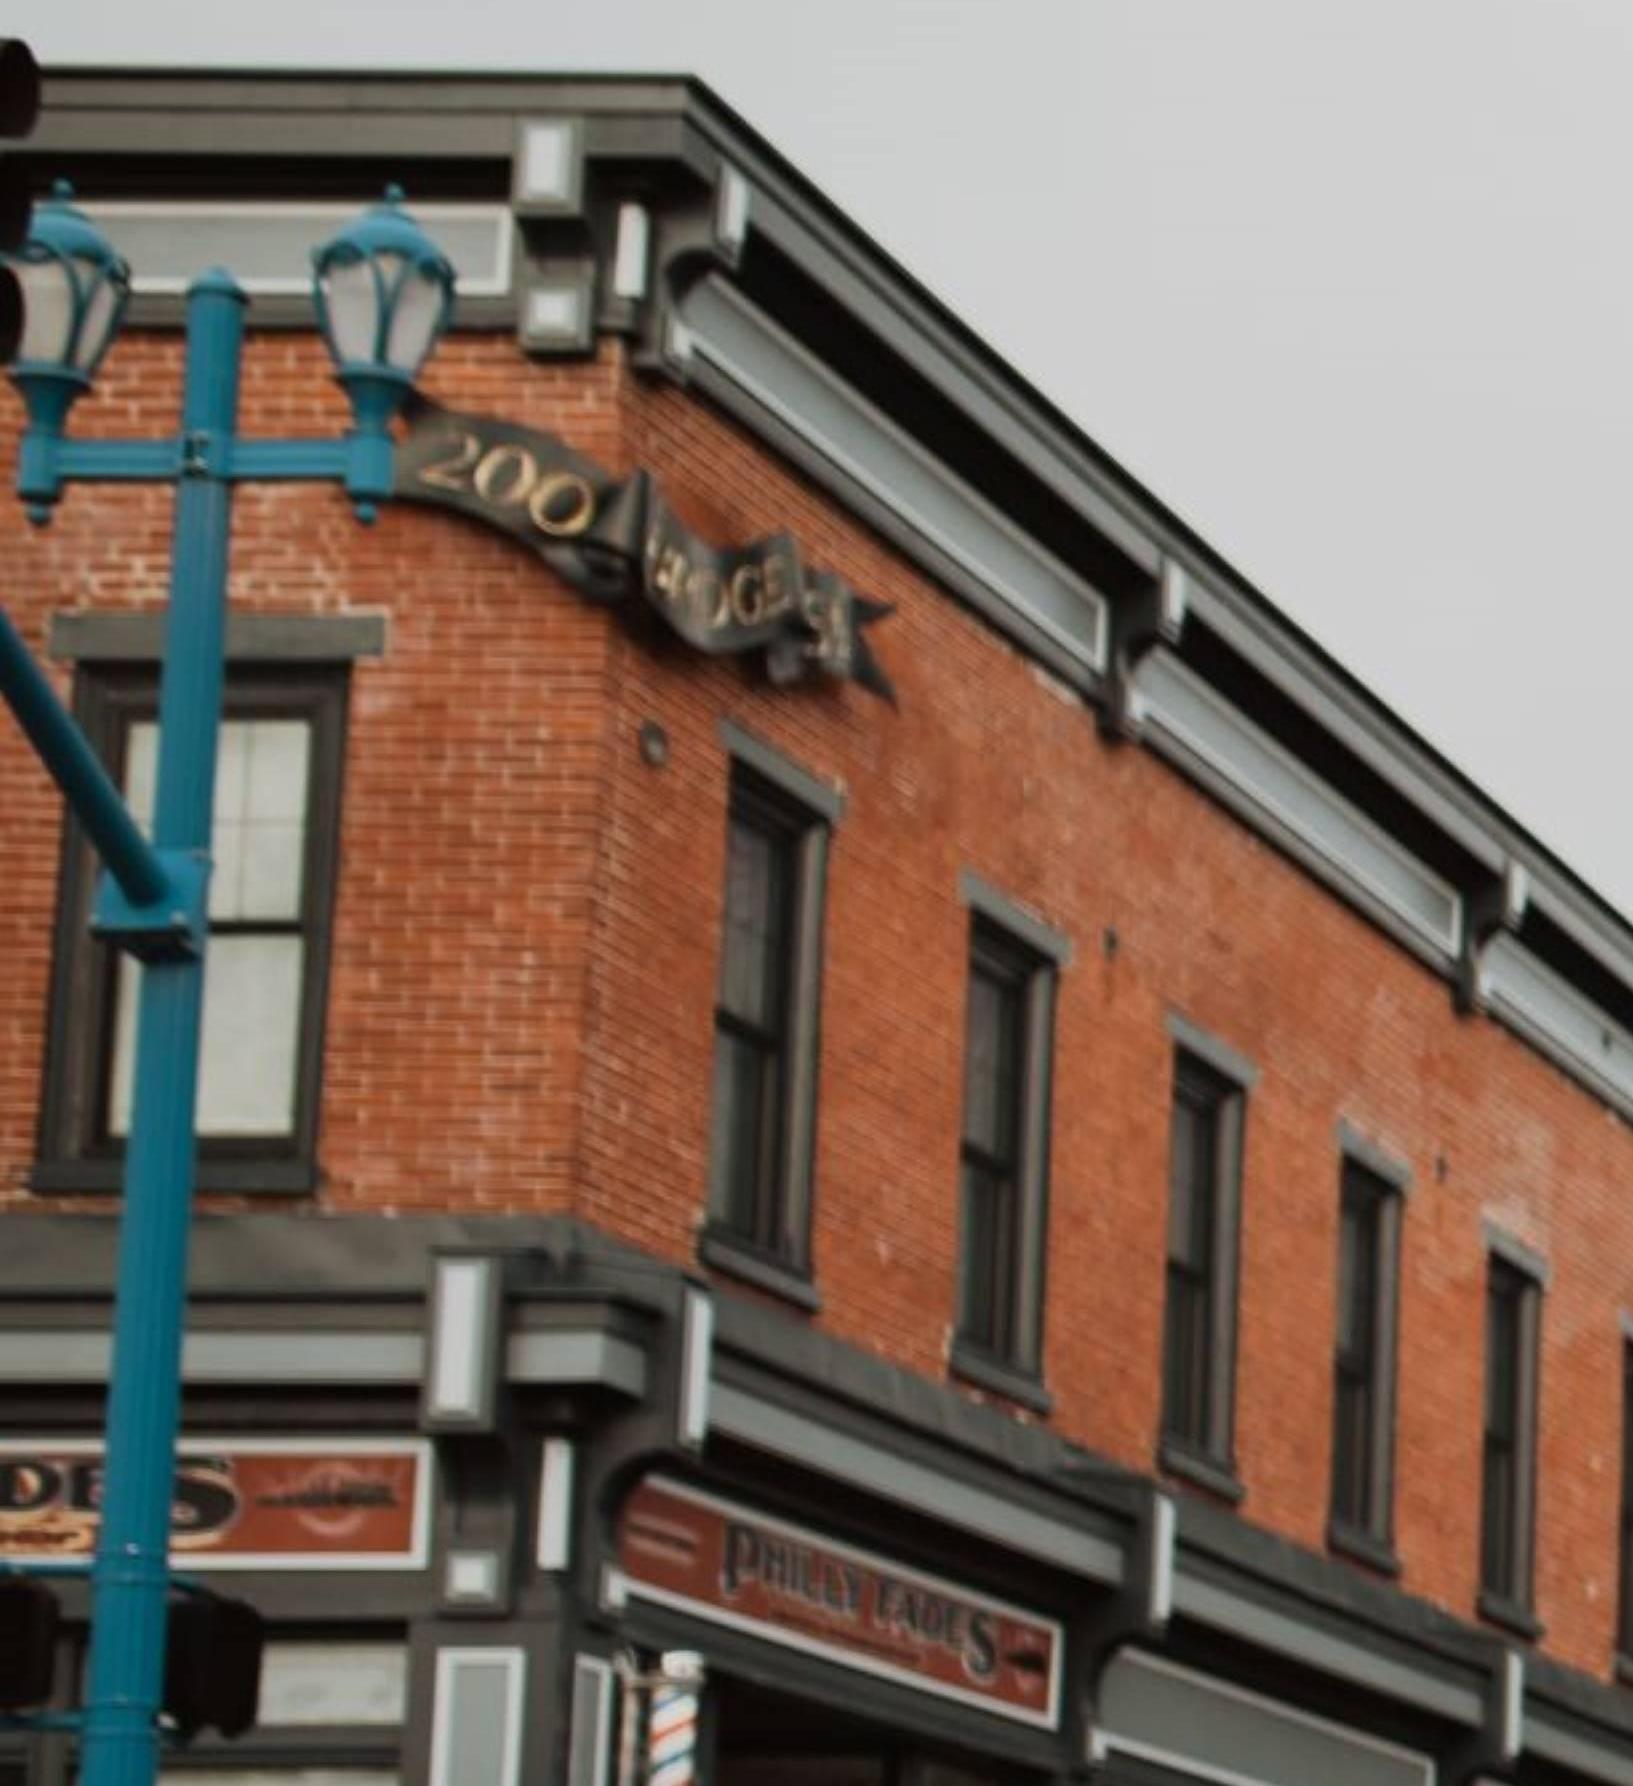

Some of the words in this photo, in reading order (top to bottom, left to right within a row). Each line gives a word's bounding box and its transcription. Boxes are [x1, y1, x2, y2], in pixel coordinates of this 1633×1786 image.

[419, 432, 594, 537] 200
[719, 1516, 862, 1618] PHILLY
[873, 1574, 1000, 1686] FADES
